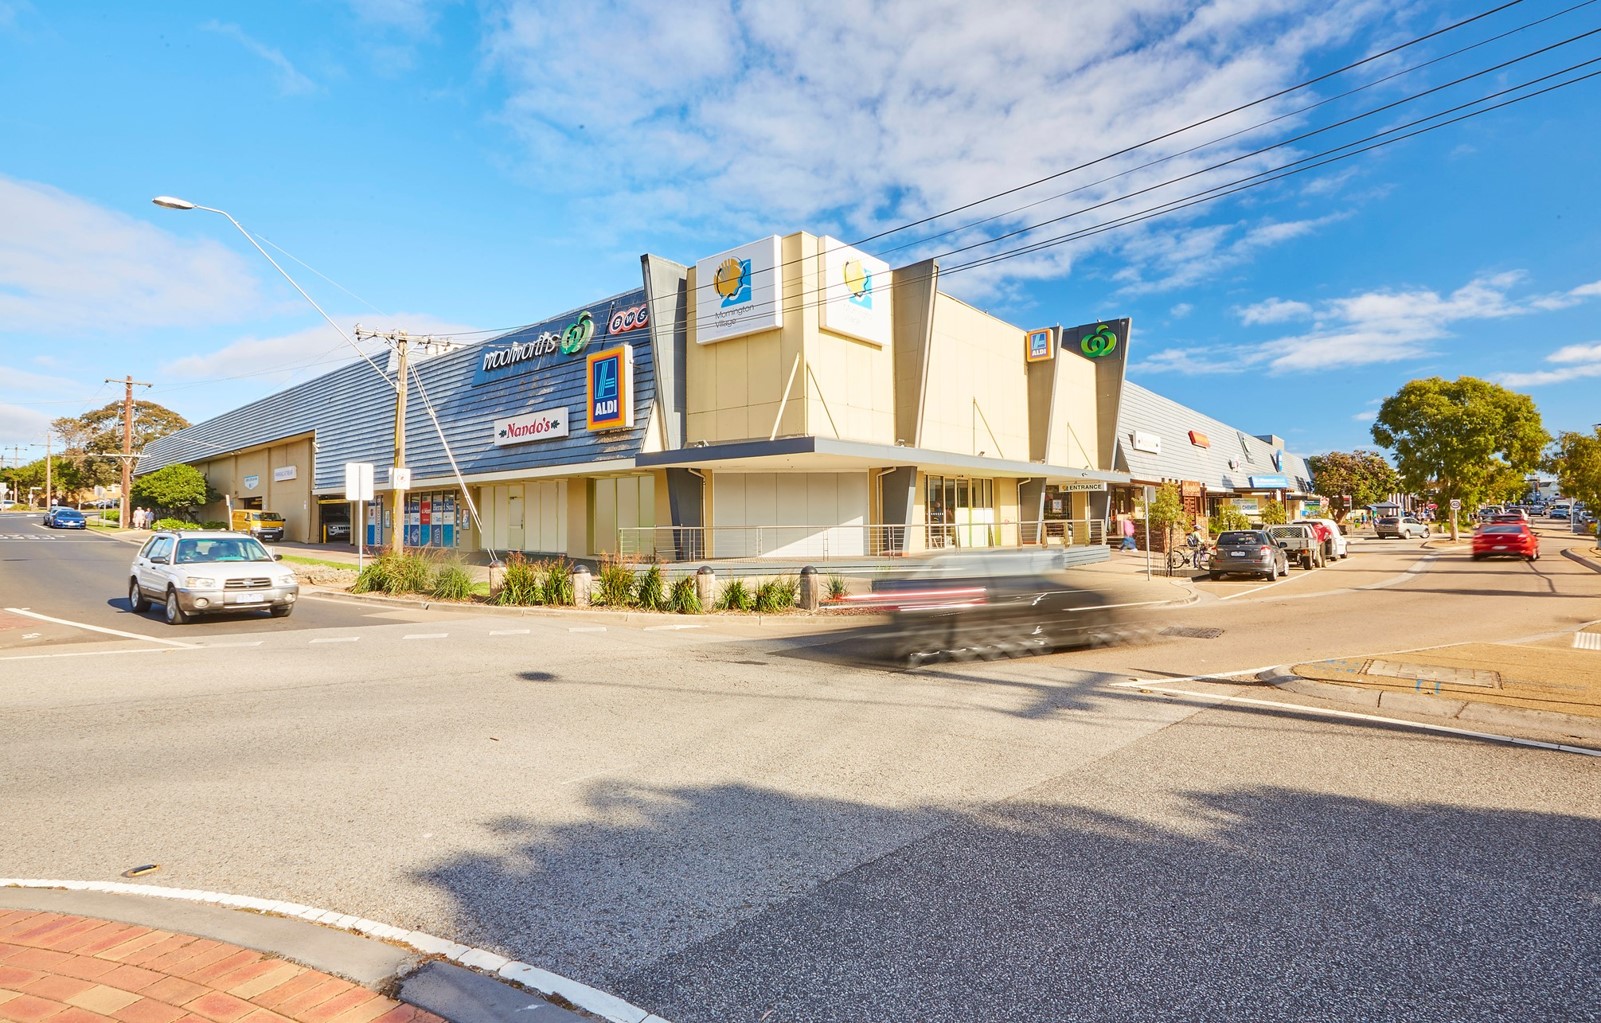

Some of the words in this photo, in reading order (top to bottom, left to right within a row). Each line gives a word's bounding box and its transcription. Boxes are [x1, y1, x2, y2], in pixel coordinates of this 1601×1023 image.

[614, 310, 647, 327] BWS
[715, 304, 754, 319] Mornington
[714, 318, 737, 328] Village
[1032, 348, 1047, 357] ALDI
[595, 400, 618, 416] ALDI
[506, 417, 551, 438] Nando's
